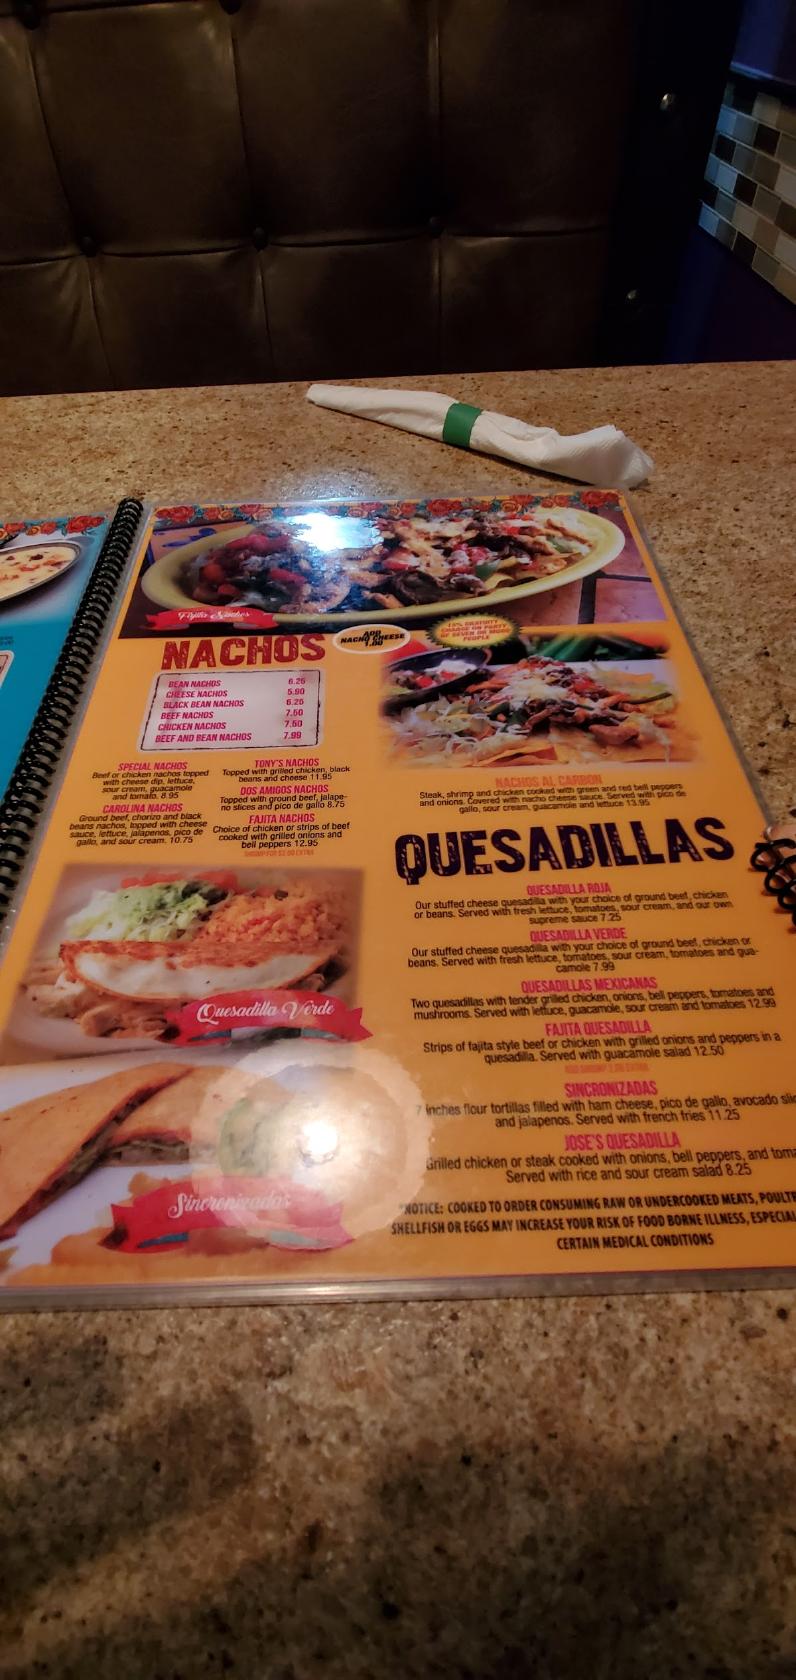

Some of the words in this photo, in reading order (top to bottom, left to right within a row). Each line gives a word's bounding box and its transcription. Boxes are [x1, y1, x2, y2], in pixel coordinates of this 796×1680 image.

[161, 633, 326, 670] NACHOS
[158, 723, 193, 731] CHICKEN
[196, 722, 226, 730] NACHOS
[177, 734, 194, 742] AND
[118, 763, 151, 771] SPECIAL
[154, 762, 187, 770] NACHOS
[255, 760, 283, 768] TONY'S
[286, 758, 319, 767] NACHOS
[280, 774, 307, 782] cheese
[240, 787, 257, 795] DOS
[260, 786, 291, 794] AMIGOS
[294, 785, 328, 794] NACHOS
[103, 804, 145, 814] CAROLINA
[148, 804, 182, 812] NACHOS
[274, 802, 291, 810] pico
[306, 801, 325, 810] gallo
[249, 815, 276, 824] FAJITA
[280, 814, 315, 823] NACHOS
[253, 824, 284, 832] chicken
[297, 823, 319, 832] strips
[270, 832, 295, 841] grilled
[259, 841, 292, 849] peppers
[395, 817, 734, 885] QUESADILLAS
[527, 884, 585, 896] QUESADILLA
[588, 883, 611, 893] ROJA
[529, 916, 569, 925] supreme
[571, 914, 598, 923] sauce
[601, 913, 621, 922] 7.25
[530, 929, 592, 942] QUESADILLA
[594, 927, 627, 939] VERDE
[556, 963, 591, 972] camole
[594, 962, 615, 971] 7.99
[521, 979, 592, 993] QUESADILLAS
[595, 977, 657, 990] MEXICANAS
[196, 1000, 277, 1025] Quesadilla
[281, 1000, 334, 1019] Verde
[545, 1023, 581, 1036] FAJITA
[584, 1020, 652, 1035] QUESADILLA
[565, 1081, 657, 1098] SINCRONIZADAS
[426, 1104, 461, 1116] inches
[464, 1104, 487, 1114] flour
[491, 1102, 531, 1114] tortillas
[533, 1101, 559, 1112] filled
[562, 1101, 586, 1112] with
[589, 1100, 611, 1110] ham
[660, 1099, 682, 1110] pico
[685, 1097, 698, 1107] de
[733, 1094, 778, 1106] avocado
[496, 1117, 515, 1127] and
[577, 1112, 613, 1125] Served
[618, 1112, 640, 1123] with
[643, 1110, 677, 1122] french
[681, 1110, 705, 1121] fries
[709, 1109, 740, 1121] 11.25
[565, 1134, 603, 1151] JOSE'S
[607, 1132, 681, 1149] QUESADILLA
[426, 1157, 460, 1170] Grilled
[465, 1156, 507, 1169] chicken
[511, 1157, 522, 1167] or
[525, 1155, 555, 1166] steak
[559, 1153, 599, 1166] cooked
[602, 1153, 626, 1165] with
[673, 1151, 693, 1162] bell
[749, 1148, 768, 1160] and
[506, 1170, 545, 1183] Served
[548, 1169, 573, 1181] with
[576, 1168, 597, 1180] rice
[601, 1167, 622, 1180] and
[626, 1167, 649, 1179] sour
[654, 1167, 689, 1178] cream
[693, 1164, 723, 1176] salad
[726, 1163, 752, 1176] 8.25
[448, 1201, 486, 1213] COOKED
[490, 1201, 502, 1212] TO
[504, 1200, 537, 1212] ORDER
[540, 1198, 601, 1211] CONSUMING
[604, 1198, 626, 1209] RAW
[629, 1196, 643, 1208] OR
[645, 1194, 719, 1208] UNDERCOOKED
[391, 1221, 445, 1235] SHELLFISH
[447, 1221, 461, 1233] OR
[464, 1220, 489, 1233] EGGS
[492, 1220, 513, 1232] MAY
[516, 1218, 565, 1231] INCREASE
[567, 1217, 594, 1230] YOUR
[597, 1216, 620, 1229] RISK
[623, 1215, 635, 1228] OF
[638, 1215, 665, 1227] FOOD
[668, 1213, 701, 1226] BORNE
[557, 1237, 600, 1250] CERTAIN
[603, 1236, 648, 1249] MEDICAL
[651, 1233, 714, 1247] CONDITIONS
